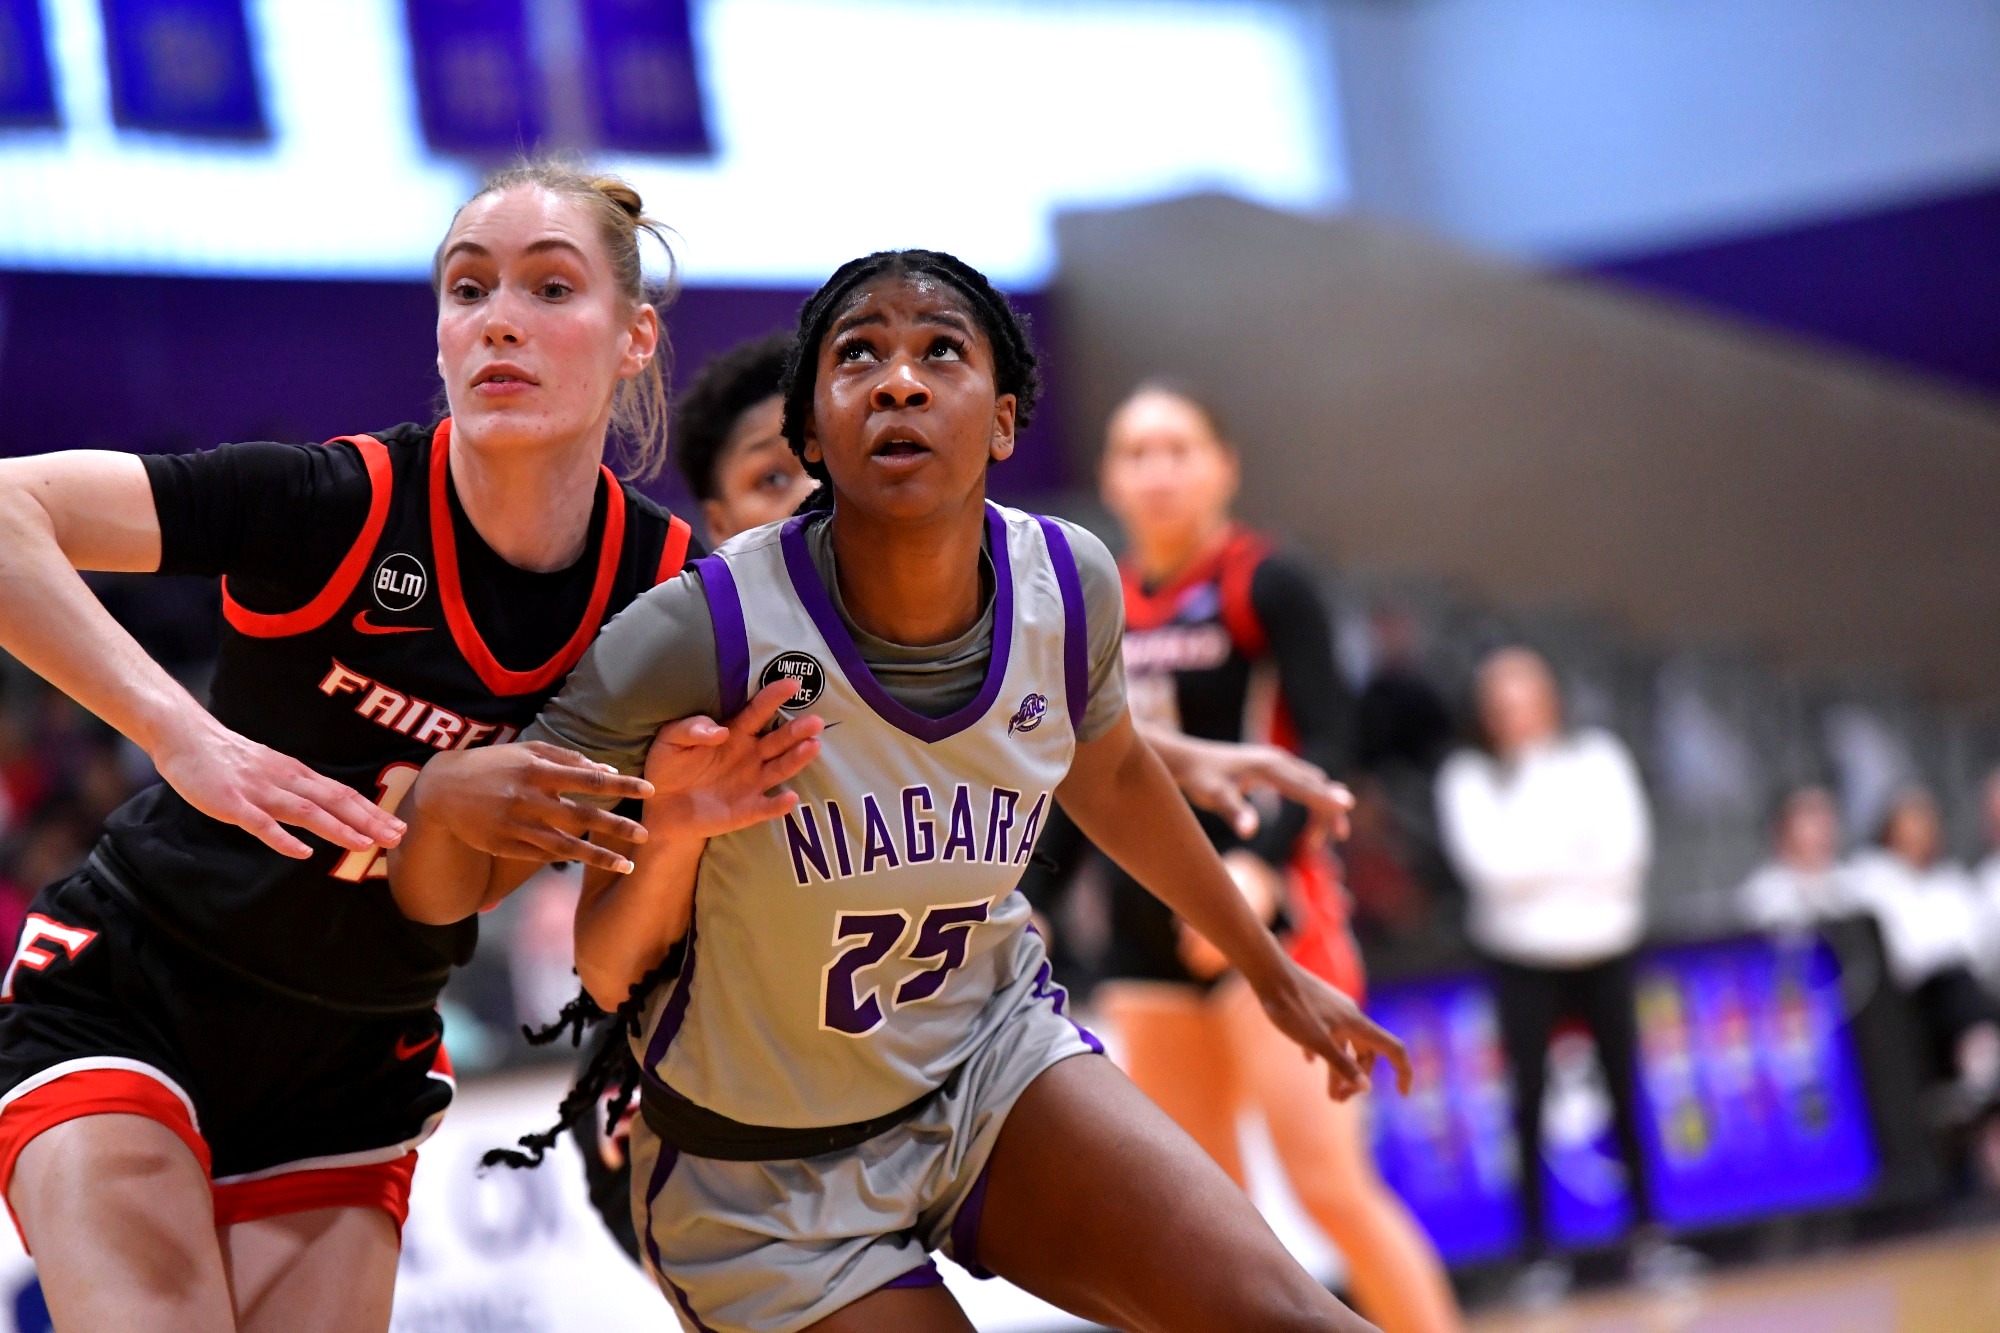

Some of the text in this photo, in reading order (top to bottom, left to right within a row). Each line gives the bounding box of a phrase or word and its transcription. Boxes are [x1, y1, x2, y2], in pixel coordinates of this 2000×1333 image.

[377, 568, 422, 597] BLM
[777, 660, 814, 676] UNITED
[784, 784, 1046, 887] NIAGARA
[818, 895, 996, 1038] 25
